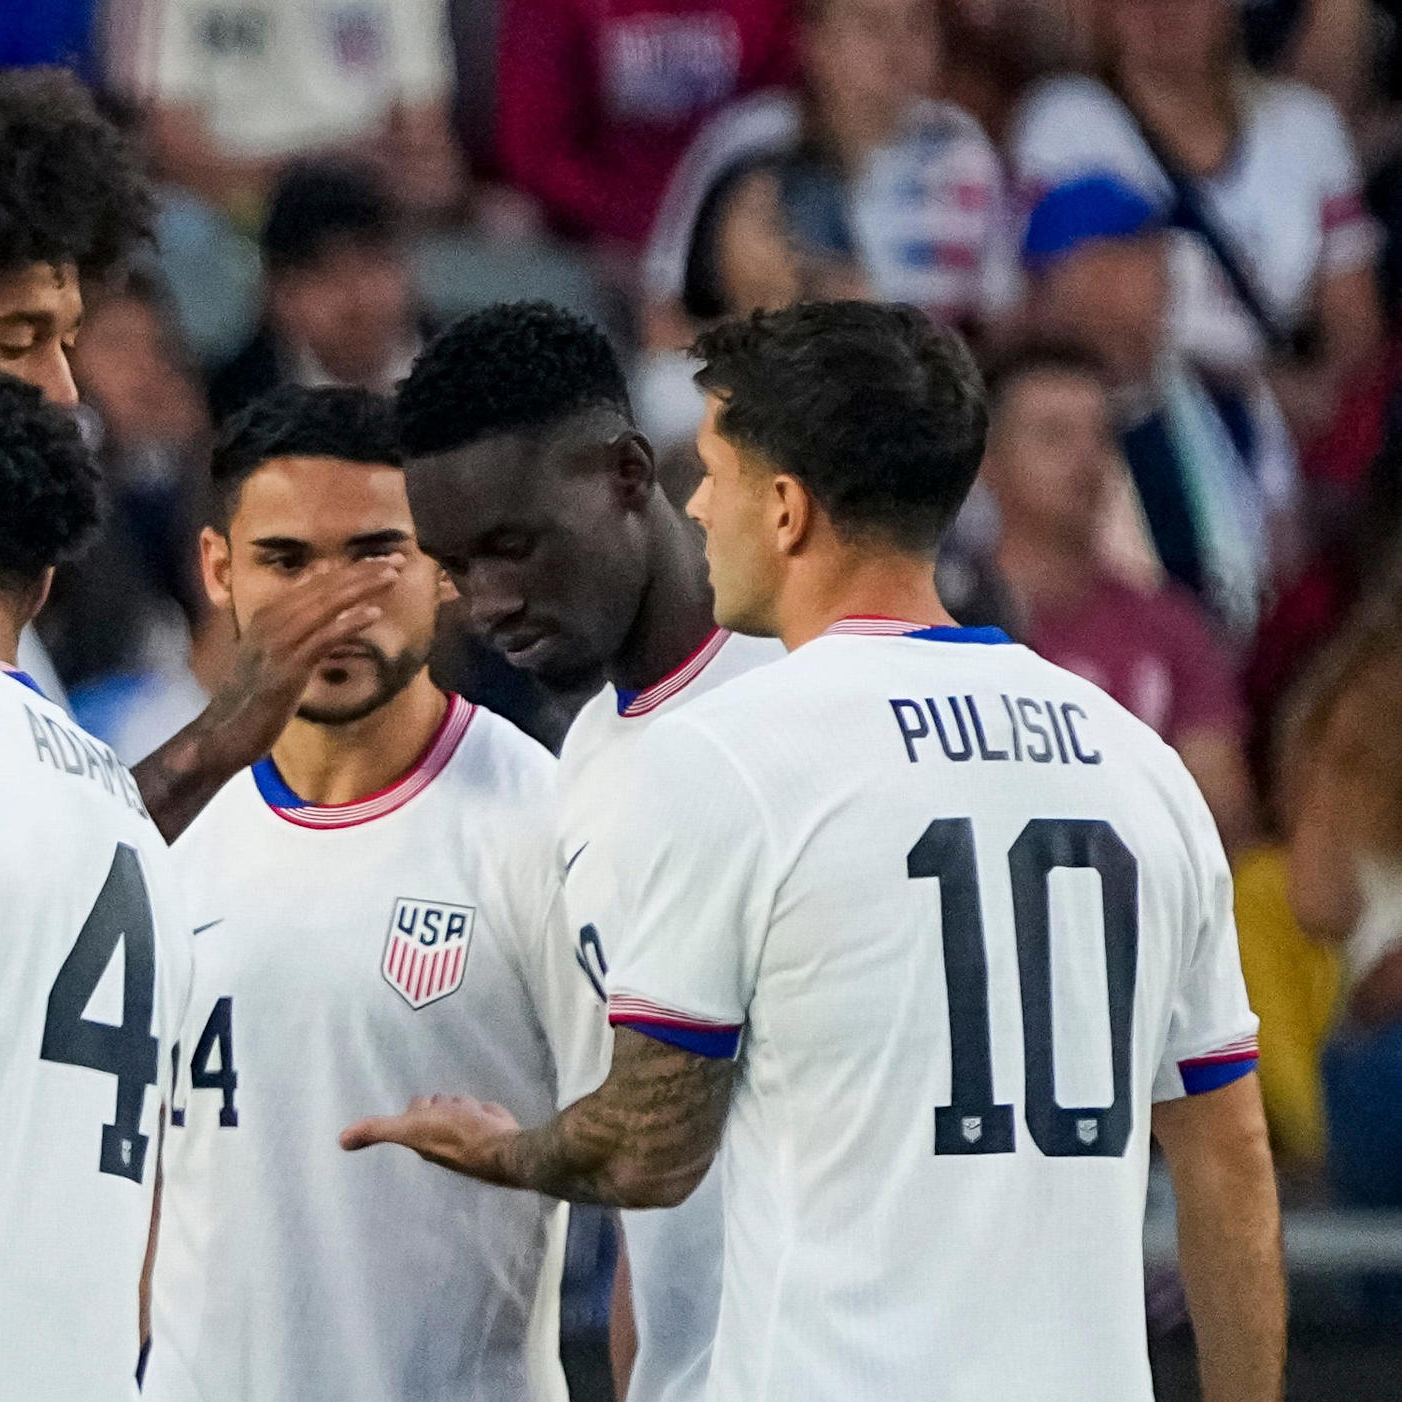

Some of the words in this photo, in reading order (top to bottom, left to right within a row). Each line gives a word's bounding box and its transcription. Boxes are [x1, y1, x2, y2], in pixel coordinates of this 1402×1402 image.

[888, 694, 1102, 765] PULISIC
[398, 906, 467, 947] USA
[906, 817, 1139, 1158] 10
[39, 841, 160, 1185] 4
[171, 996, 238, 1128] 4
